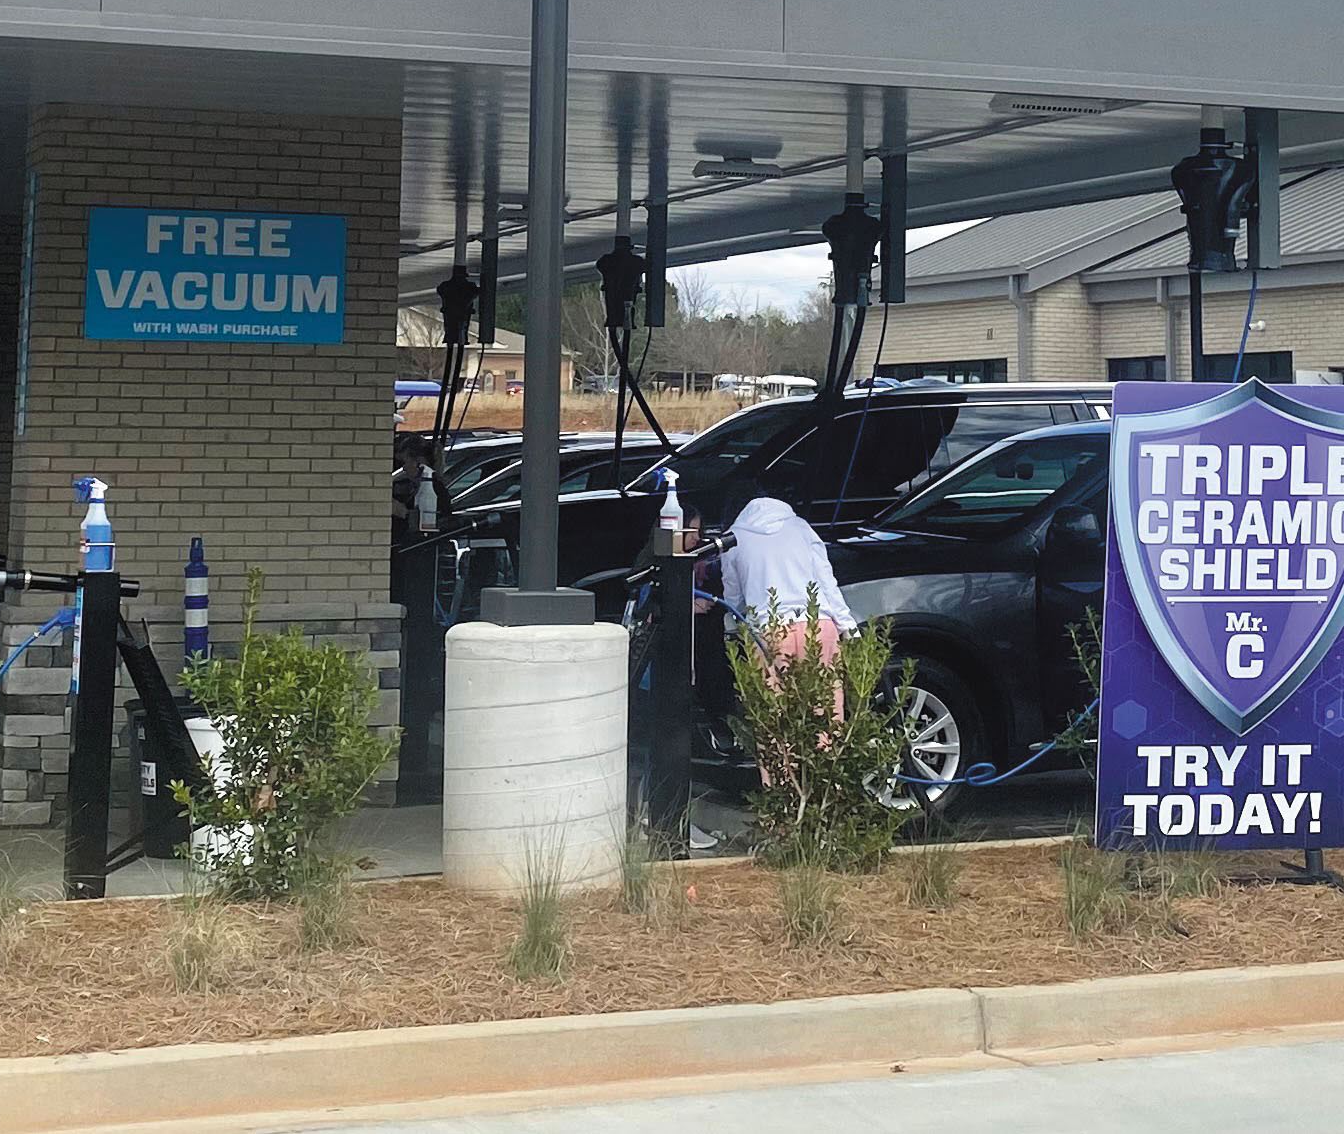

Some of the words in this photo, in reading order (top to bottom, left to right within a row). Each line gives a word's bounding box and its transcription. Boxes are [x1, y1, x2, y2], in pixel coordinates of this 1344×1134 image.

[146, 215, 292, 258] FREE
[94, 269, 338, 314] VACUUM
[132, 321, 171, 335] WITH
[176, 322, 218, 336] WASH
[223, 323, 299, 337] PURCHASE
[1158, 548, 1338, 591] SHIELD
[1225, 611, 1268, 633] Mr.
[1225, 633, 1265, 680] C
[1137, 744, 1248, 787] TRY
[1261, 743, 1312, 786] IT
[1123, 791, 1323, 837] TODAY!
